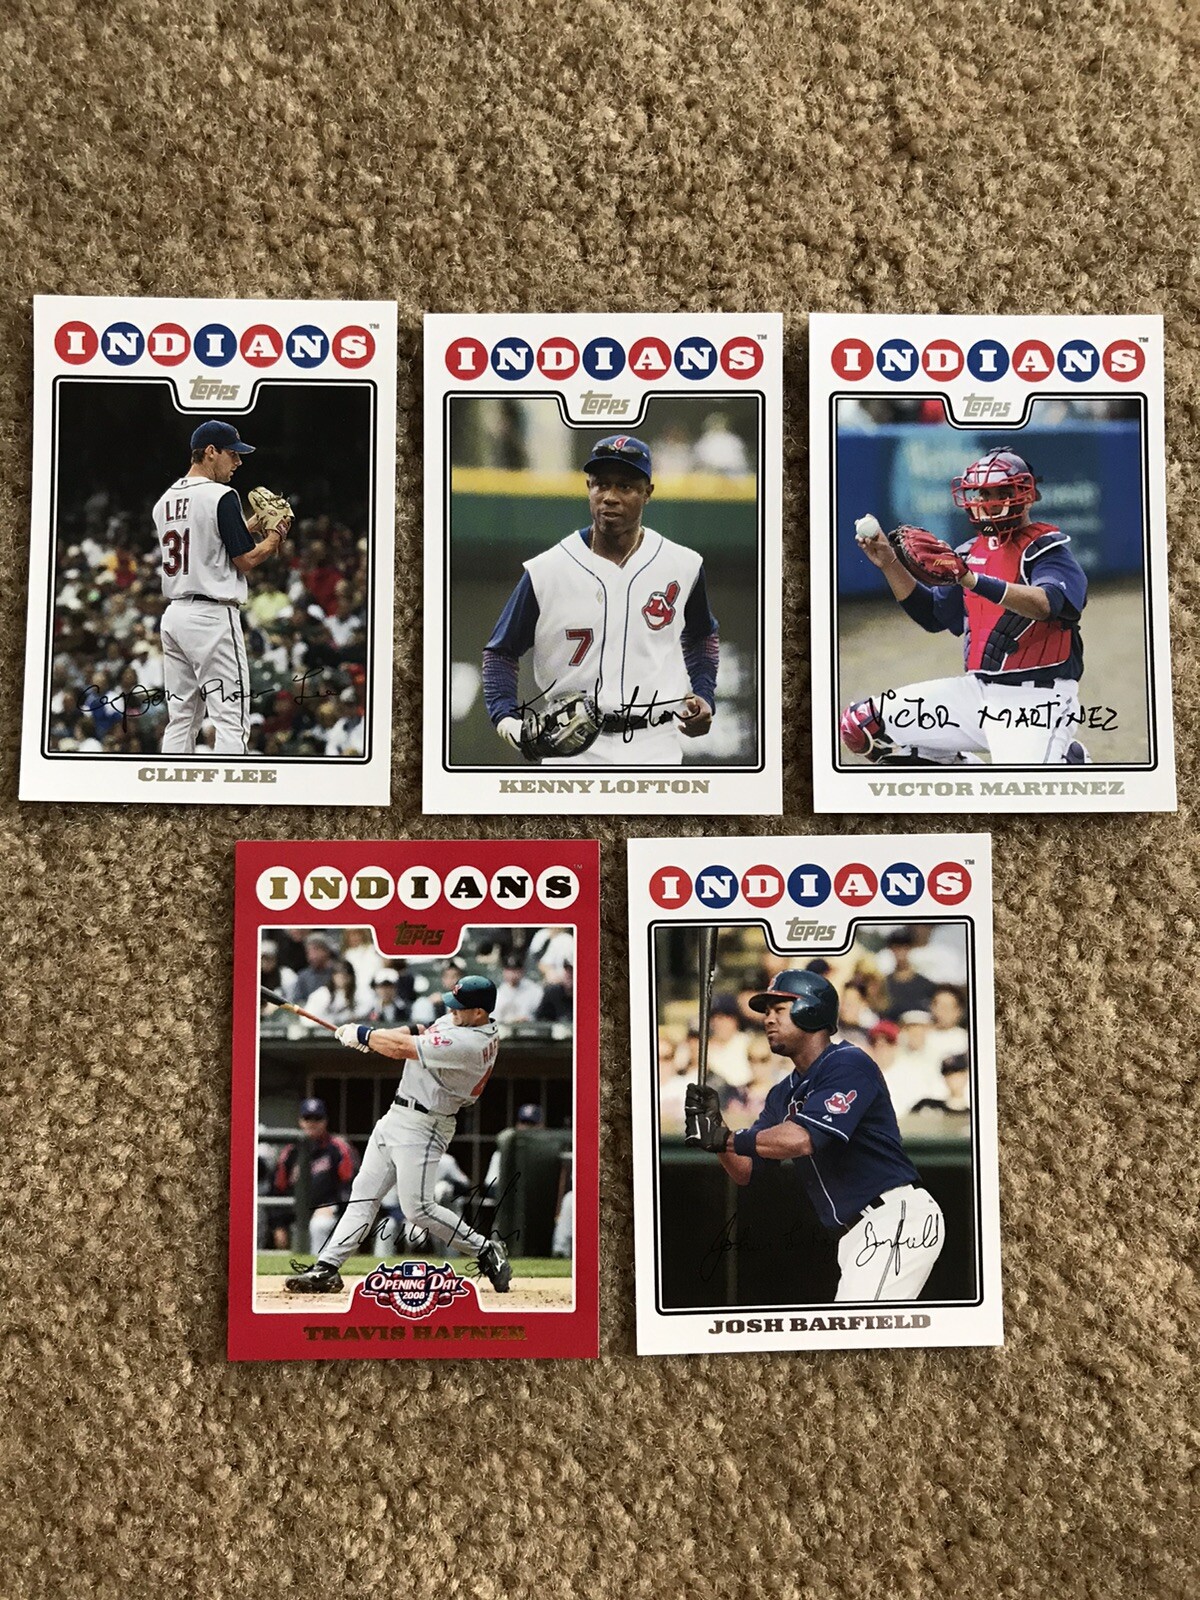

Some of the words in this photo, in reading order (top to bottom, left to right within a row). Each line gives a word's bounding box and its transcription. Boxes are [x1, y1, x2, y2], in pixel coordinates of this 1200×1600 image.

[65, 330, 369, 360] INDIANS
[455, 346, 757, 371] INDIANS
[842, 347, 1139, 374] INDIANS
[165, 498, 190, 522] LEE
[162, 528, 190, 577] 31
[565, 628, 594, 667] 7
[137, 767, 220, 783] CLIFF
[223, 769, 277, 783] LEE
[498, 779, 595, 794] KENNY
[599, 779, 711, 794] LOFTON
[867, 782, 975, 797] VICTOR
[979, 781, 1126, 796] MARTINEZ
[268, 875, 573, 900] INDIANS
[660, 870, 964, 900] INDIANS
[402, 1291, 426, 1300] 2008
[303, 1325, 407, 1341] TRAVIS
[411, 1325, 528, 1341] HAFNER
[708, 1318, 785, 1335] JOSH
[789, 1314, 932, 1332] BARFIELD
